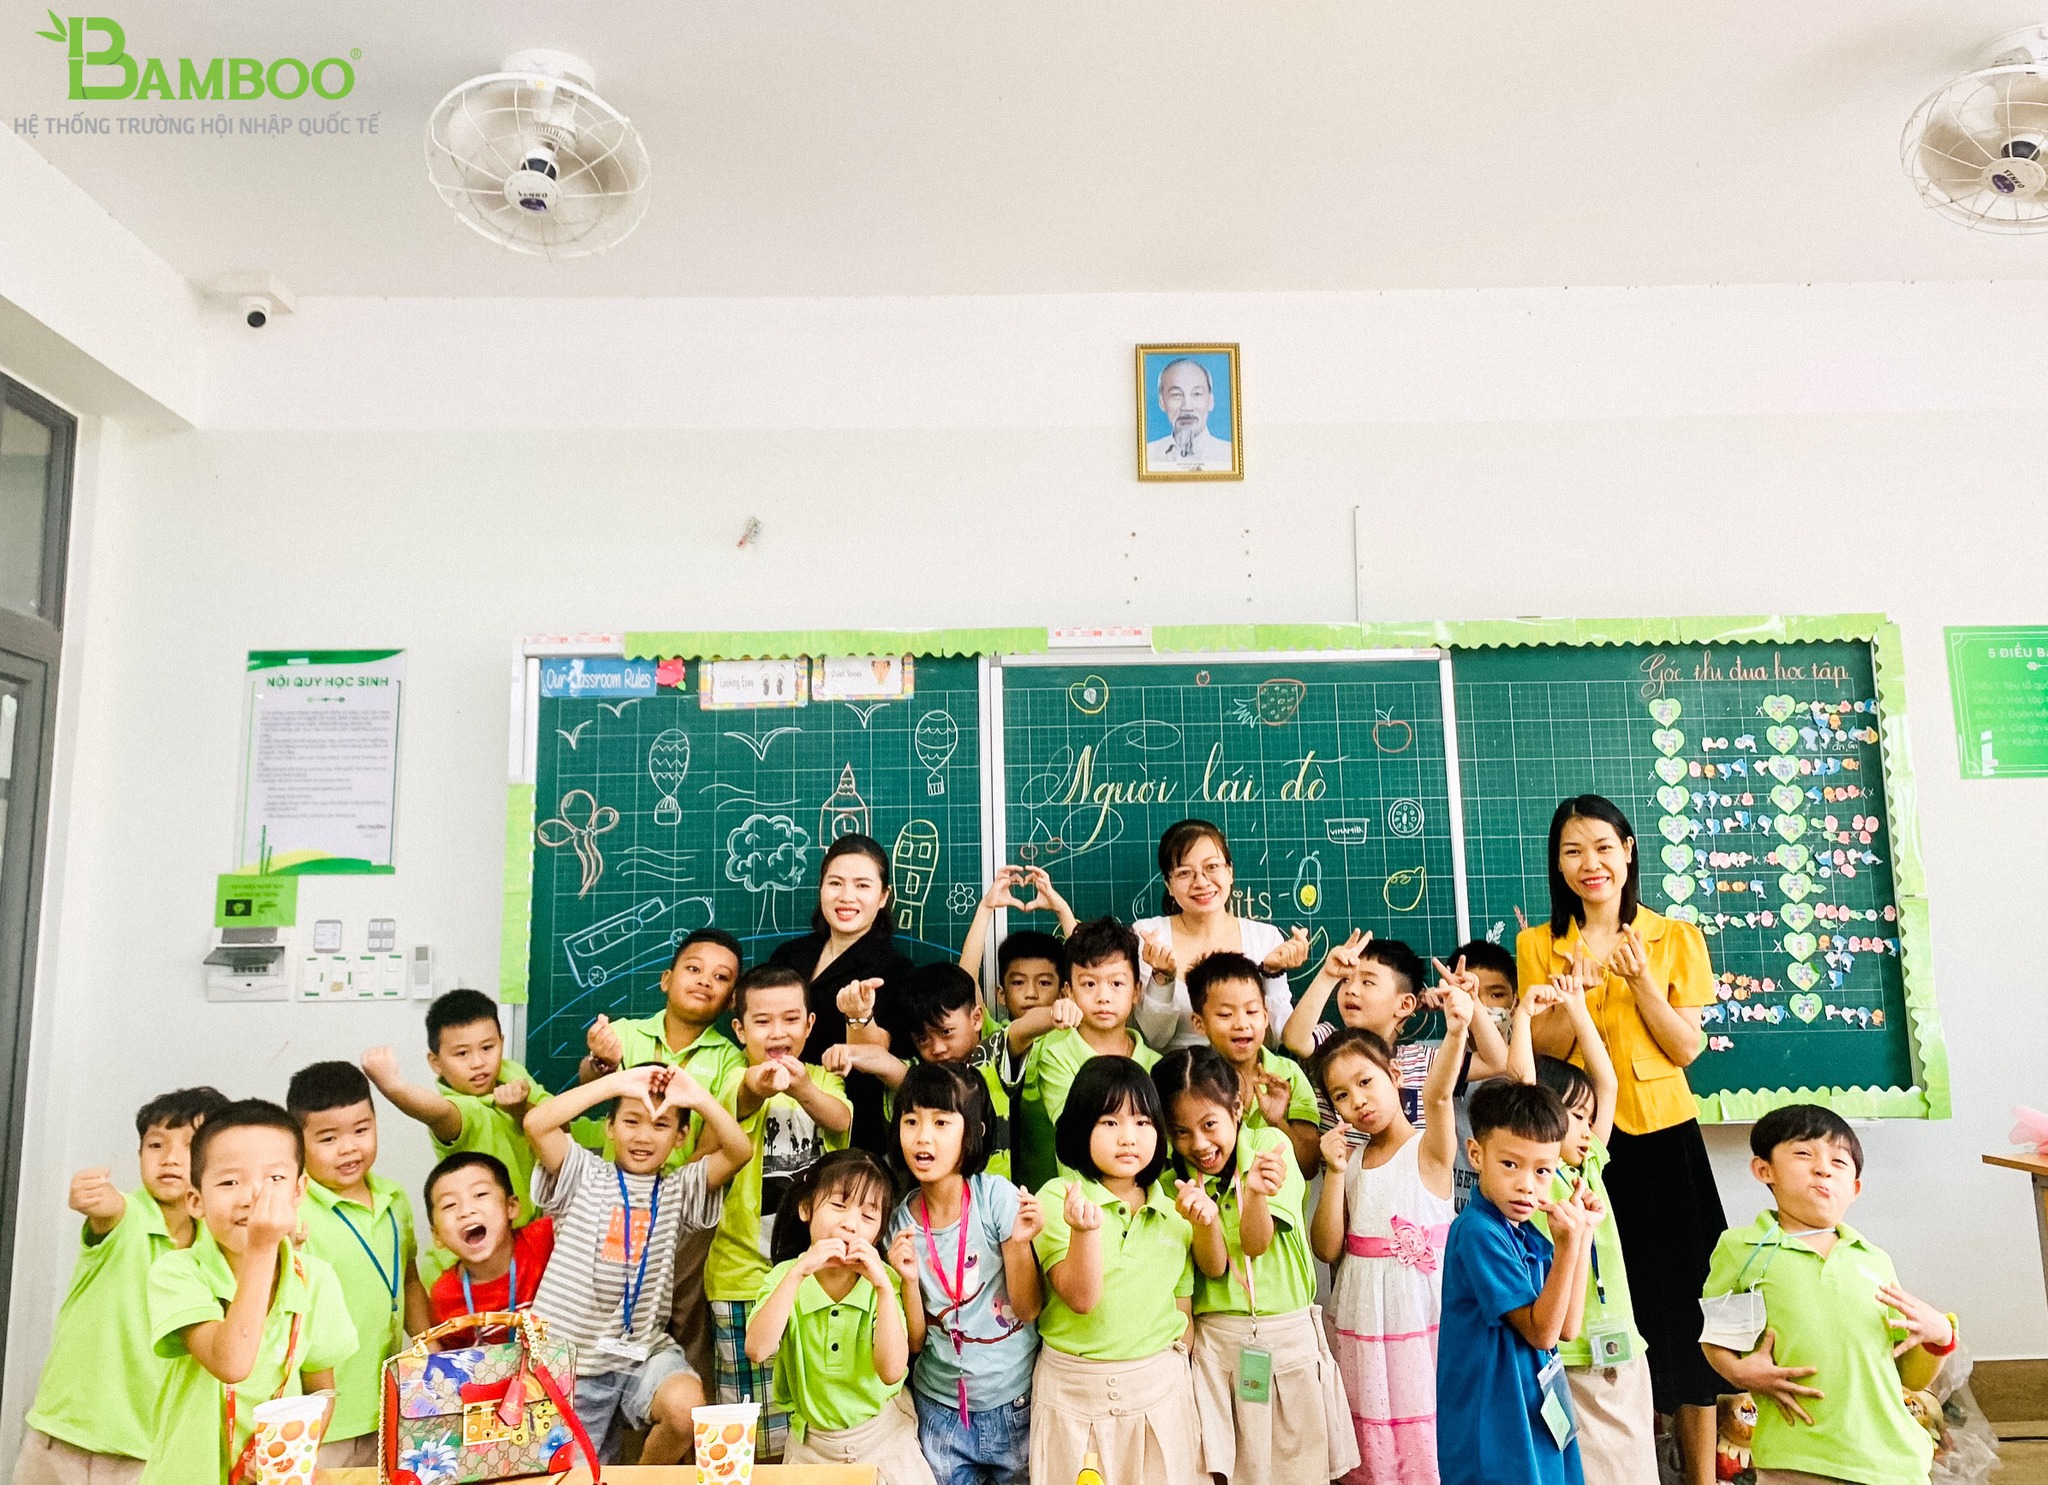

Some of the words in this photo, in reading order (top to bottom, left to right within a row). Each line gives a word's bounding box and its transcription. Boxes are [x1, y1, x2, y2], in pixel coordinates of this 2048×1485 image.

[1988, 648, 1996, 658] 5
[2000, 642, 2033, 658] ĐIỀU
[267, 674, 289, 689] NỘI
[294, 677, 321, 687] QUY
[325, 677, 353, 688] HỌC
[357, 677, 388, 687] SINH
[546, 669, 566, 689] Our
[624, 668, 651, 688] Rules
[1640, 654, 1683, 697] Góc
[1693, 651, 1723, 680] thi
[1729, 656, 1768, 680] đua
[1774, 651, 1806, 683] học
[1813, 662, 1848, 688] tập
[1021, 735, 1180, 852] Người
[1190, 741, 1261, 802] lái
[1280, 750, 1350, 801] đò
